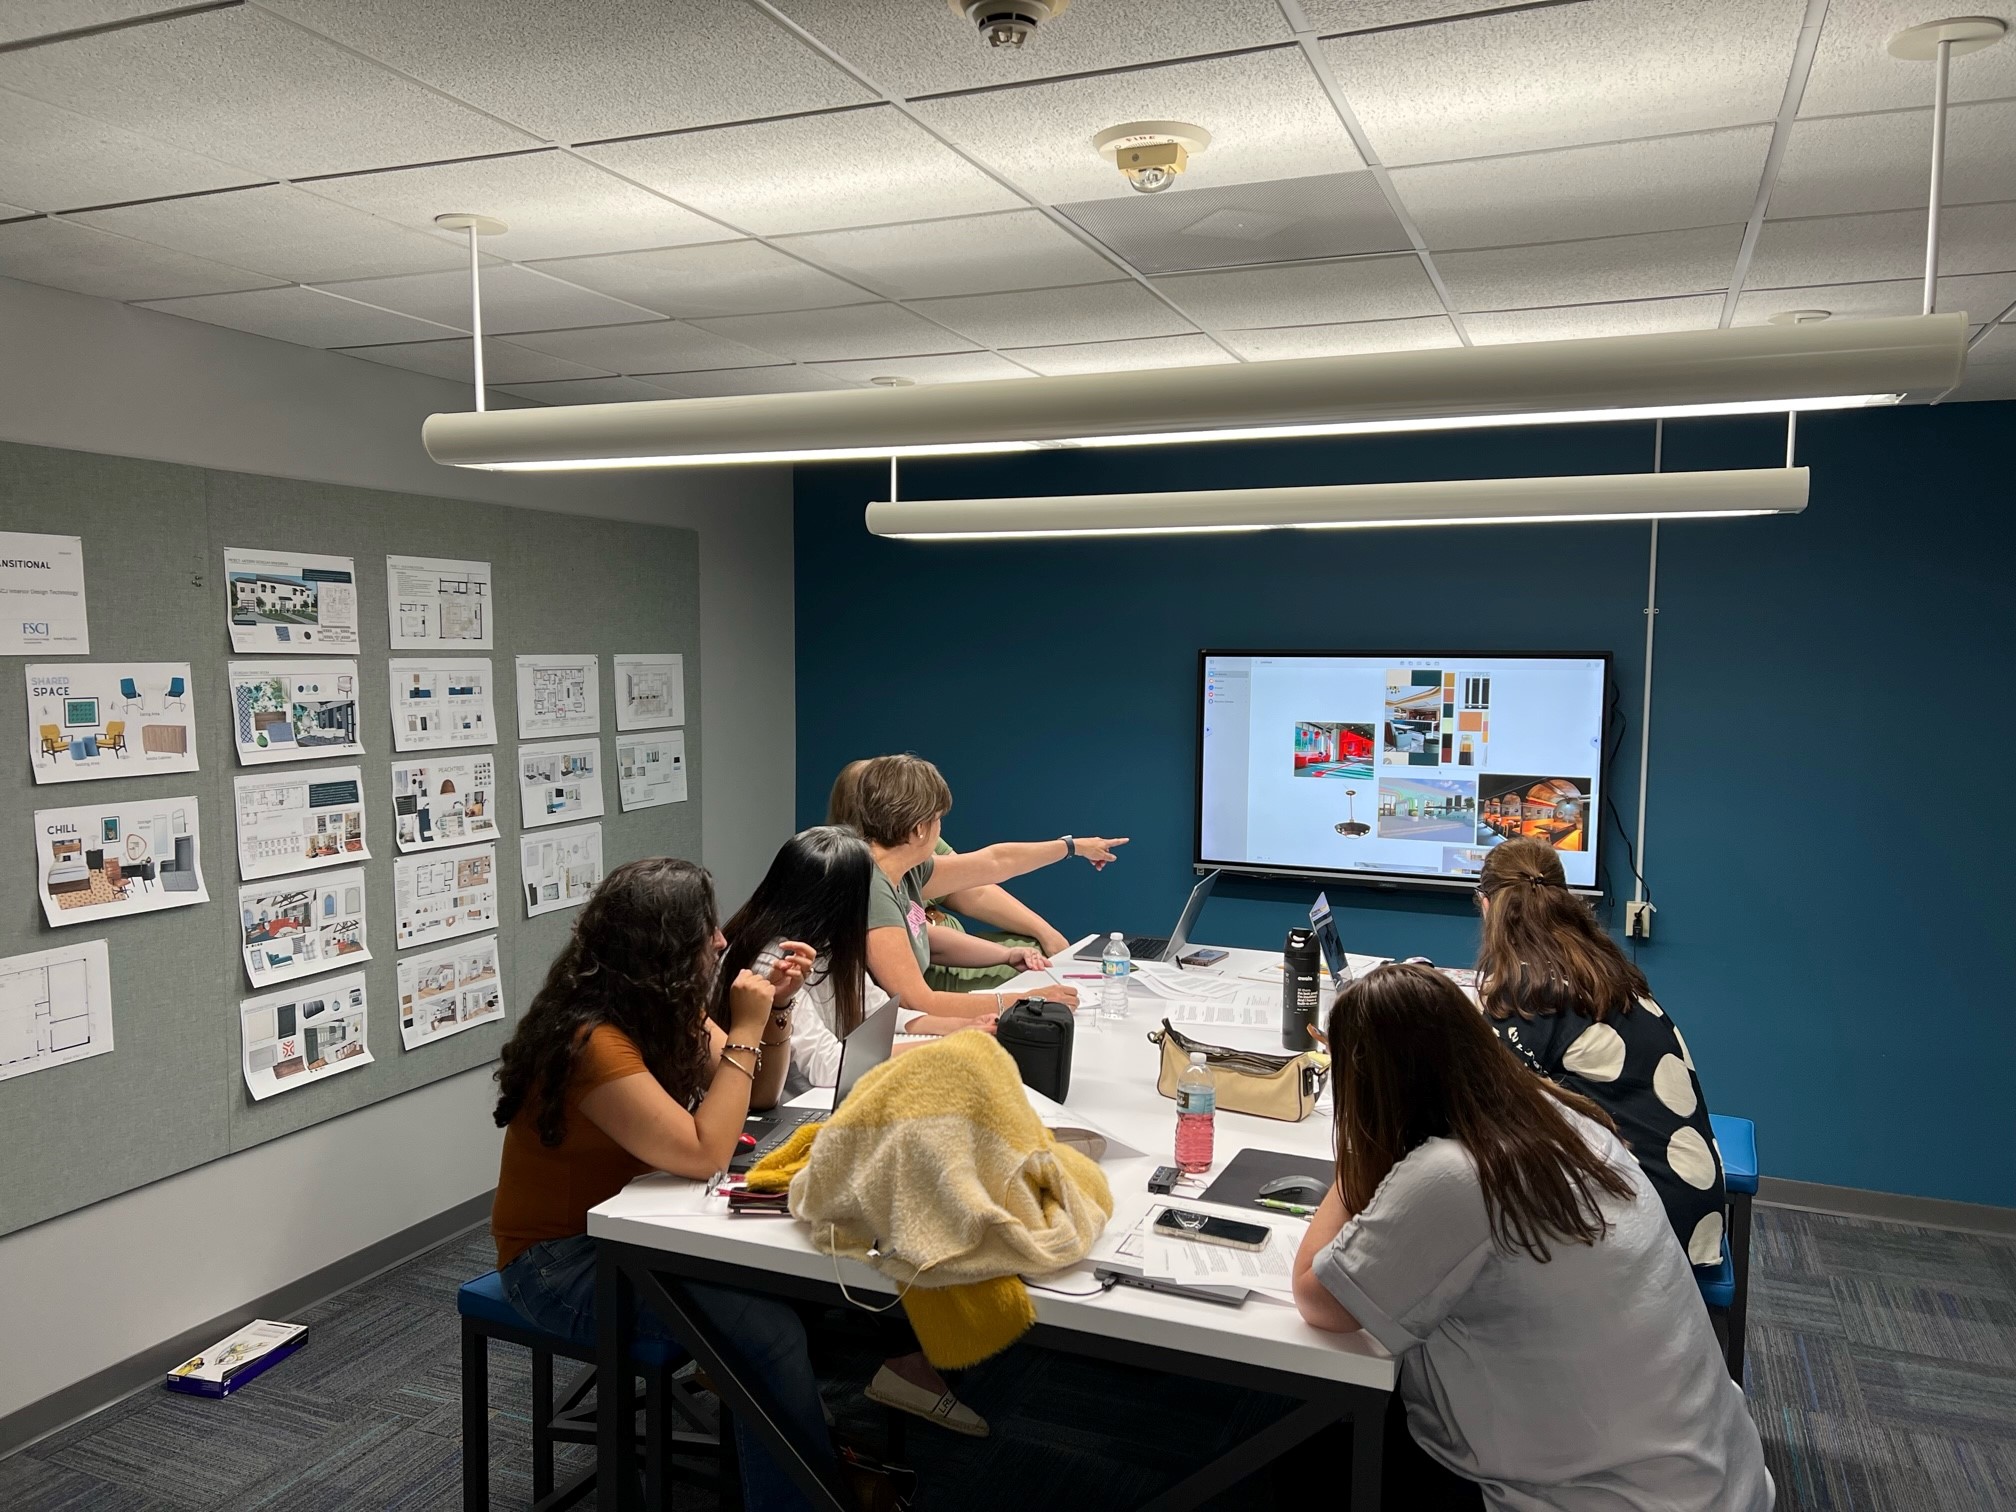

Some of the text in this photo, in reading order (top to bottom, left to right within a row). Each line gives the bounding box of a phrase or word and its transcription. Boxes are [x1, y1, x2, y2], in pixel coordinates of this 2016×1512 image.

[22, 622, 49, 636] FSCJ
[31, 676, 70, 686] SHARED
[33, 686, 70, 697] SPACE
[47, 824, 77, 835] CHILL
[938, 1397, 954, 1414] LRL
